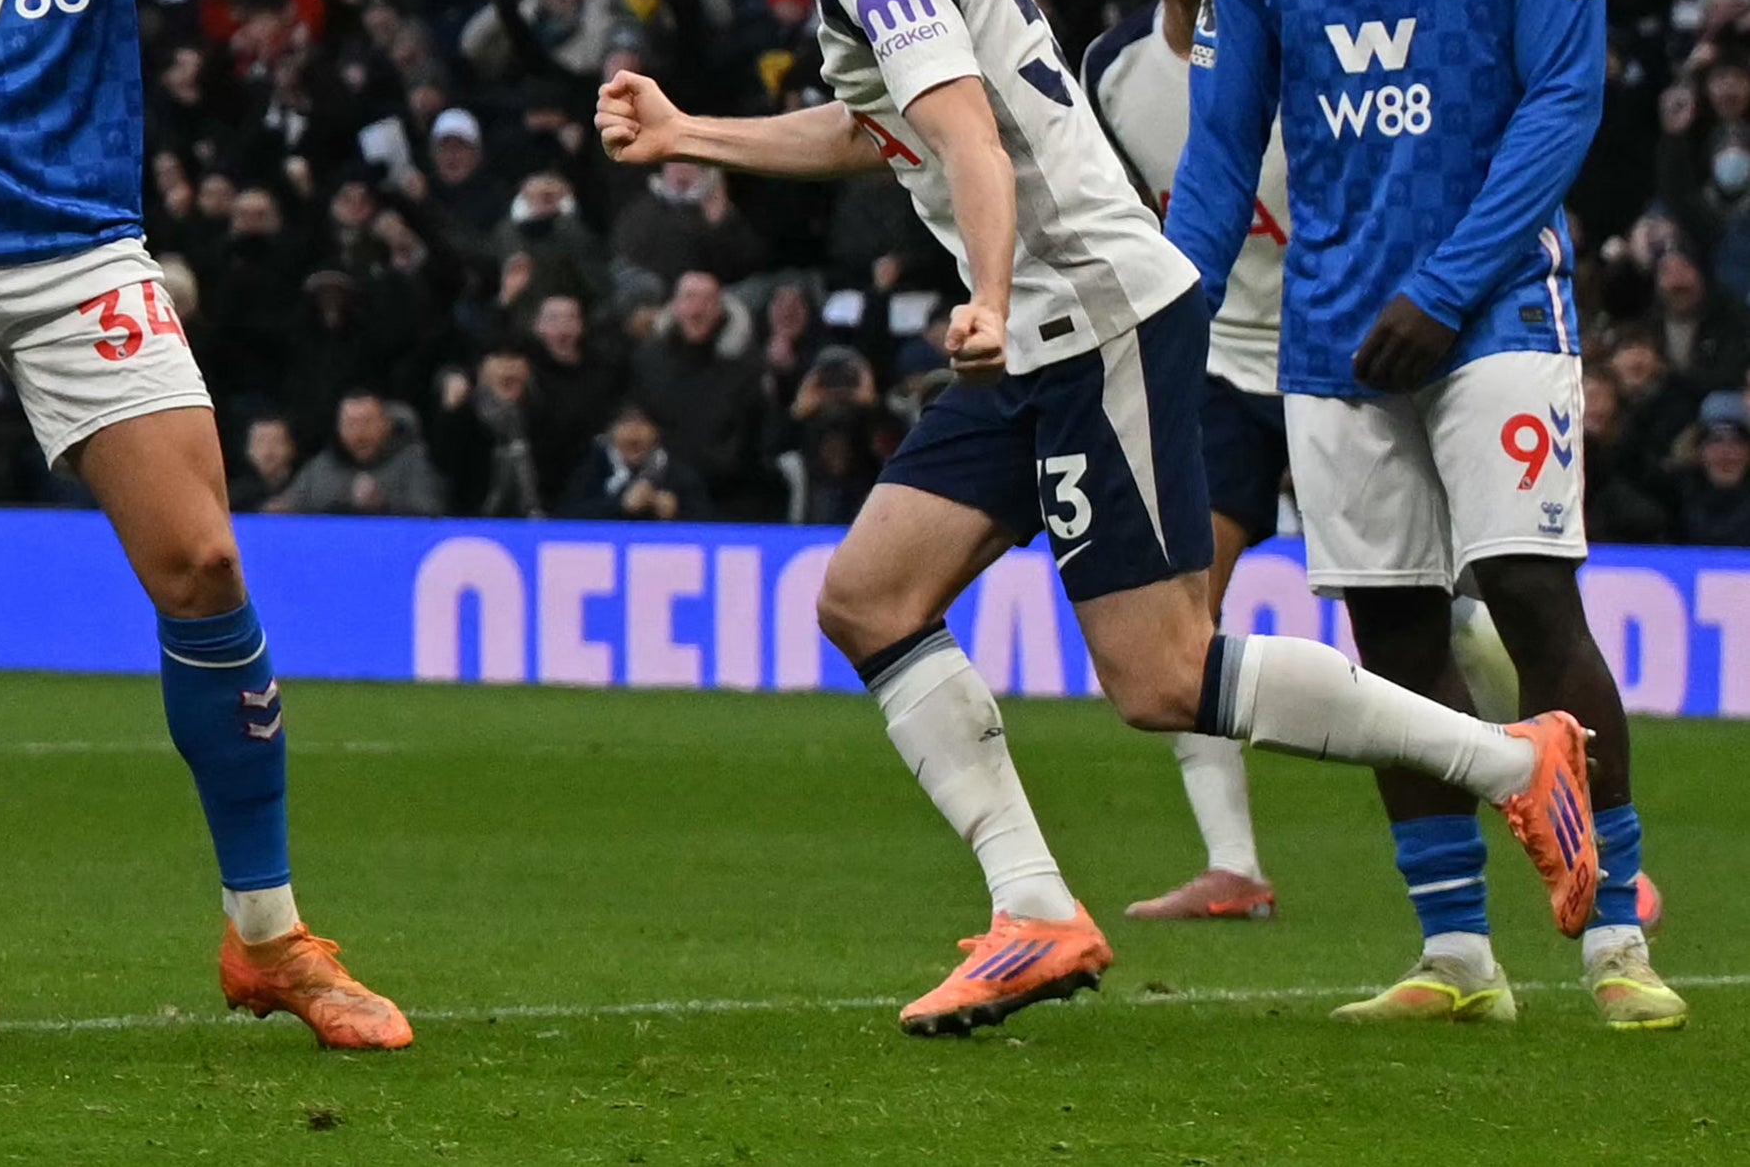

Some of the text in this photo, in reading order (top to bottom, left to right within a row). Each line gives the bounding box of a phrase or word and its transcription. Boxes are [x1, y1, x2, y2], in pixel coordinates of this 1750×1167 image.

[875, 20, 949, 64] kraken
[1318, 83, 1431, 139] W88
[77, 279, 188, 361] 34
[1501, 413, 1550, 490] 9
